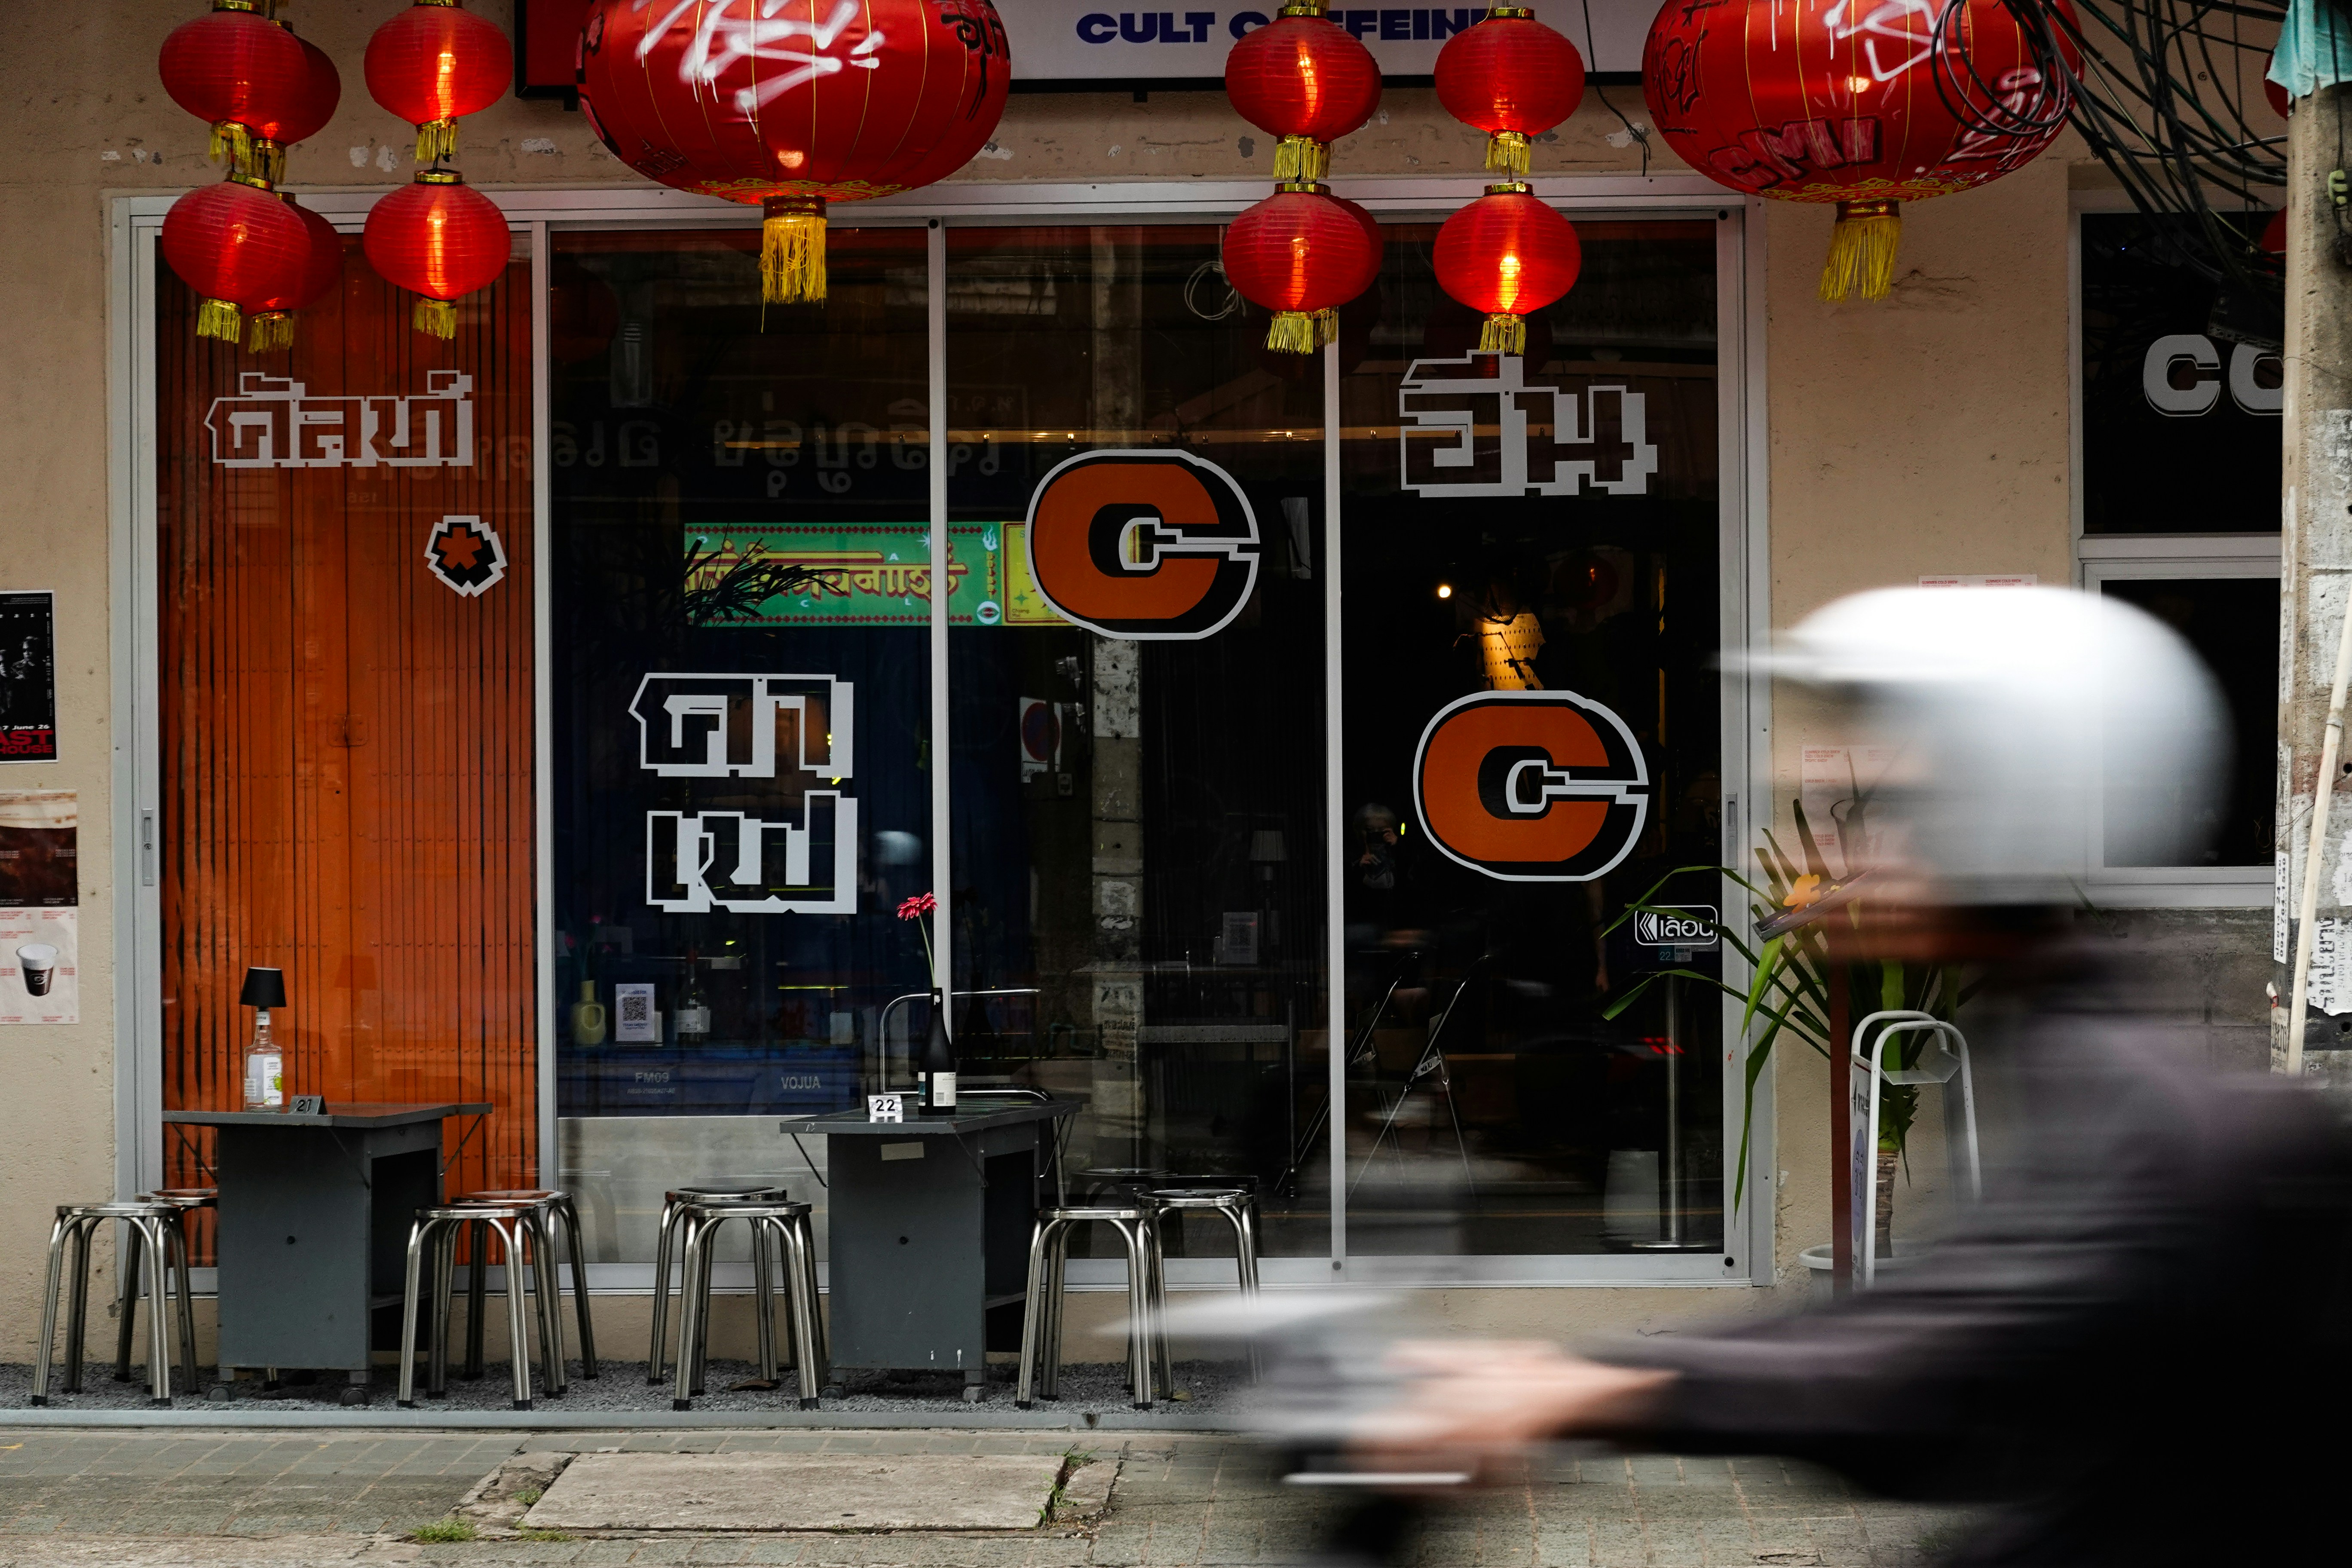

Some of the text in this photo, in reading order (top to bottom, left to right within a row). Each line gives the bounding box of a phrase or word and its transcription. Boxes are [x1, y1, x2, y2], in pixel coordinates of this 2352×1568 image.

[1076, 9, 1488, 44] CULT CFEIN
[2276, 886, 2281, 905] 24
[296, 1099, 312, 1112] 21
[876, 1099, 896, 1112] 22
